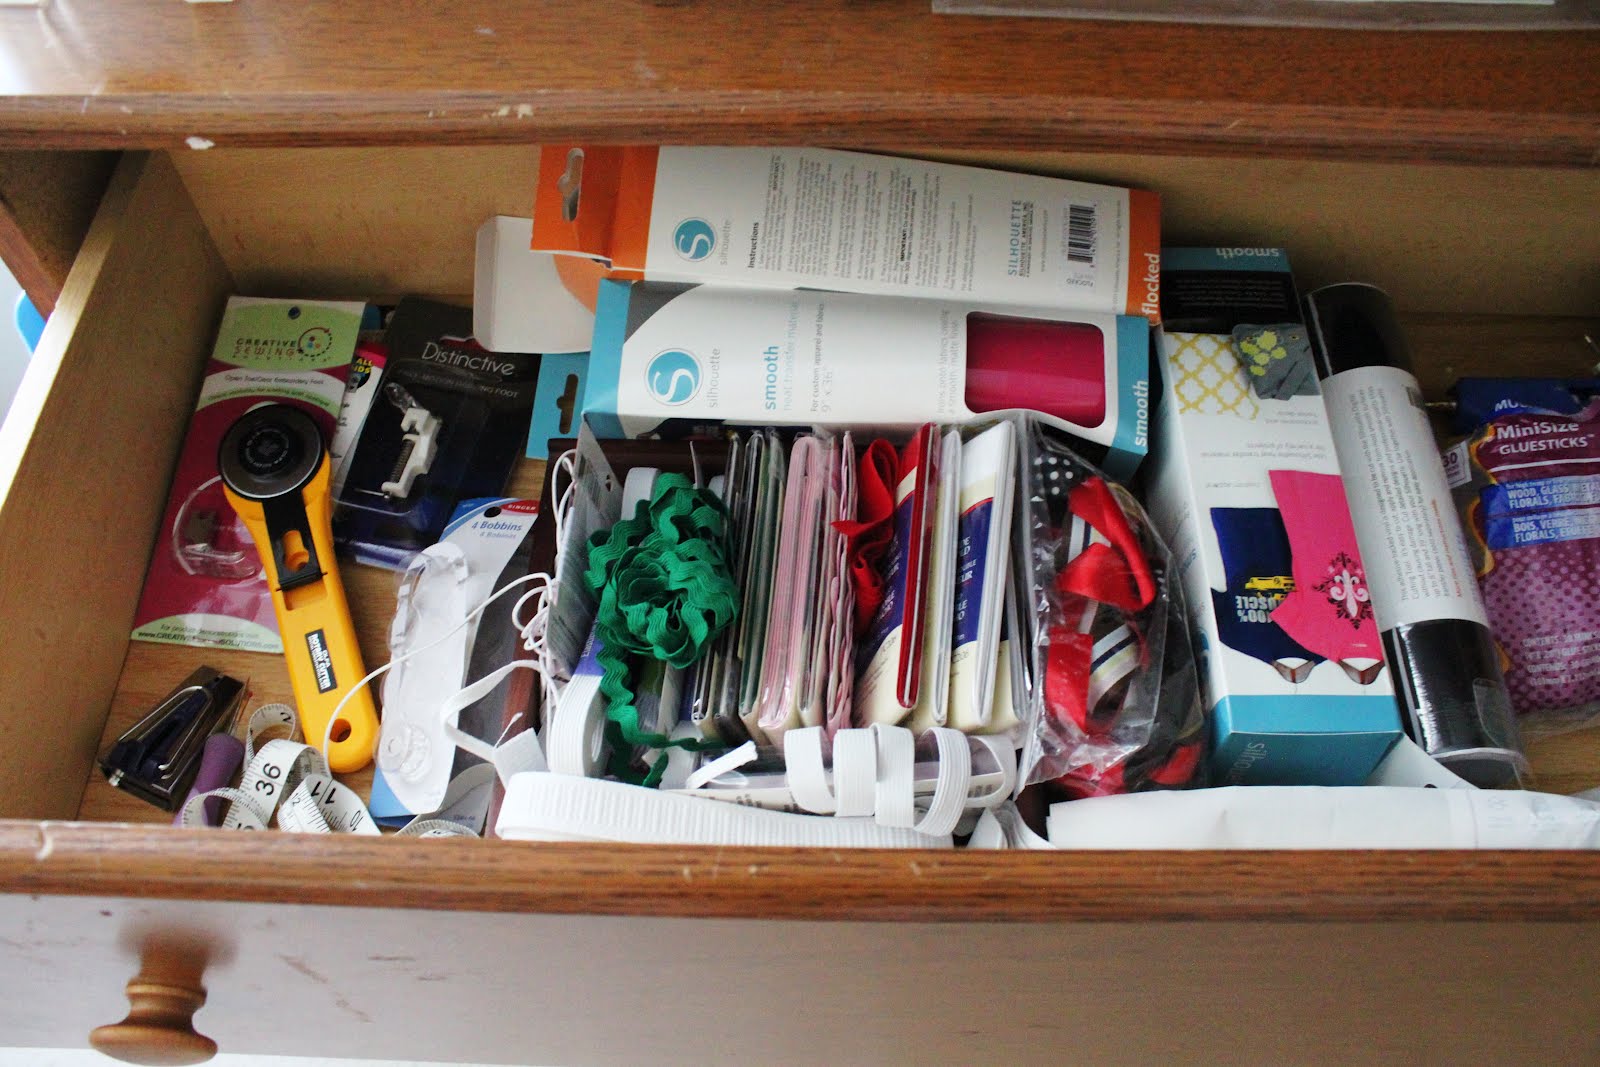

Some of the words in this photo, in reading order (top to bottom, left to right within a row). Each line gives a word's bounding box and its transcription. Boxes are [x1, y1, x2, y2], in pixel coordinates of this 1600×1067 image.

[748, 221, 760, 268] Instructions
[1008, 199, 1022, 275] SILHOUETTE
[1215, 247, 1279, 259] smooth
[1142, 252, 1160, 314] flocked
[234, 346, 295, 356] SEWING
[235, 338, 296, 347] CREATIVE
[355, 358, 373, 367] ALL
[421, 342, 516, 376] Distinctive
[705, 348, 720, 408] silhouette
[763, 345, 779, 410] smooth
[1132, 380, 1148, 446] smooth
[1496, 422, 1580, 440] MiniSize
[1499, 436, 1588, 455] GLUESTICKS
[1441, 451, 1459, 468] 30
[471, 521, 479, 530] 4
[480, 520, 523, 532] Bobbins
[255, 763, 282, 796] 36
